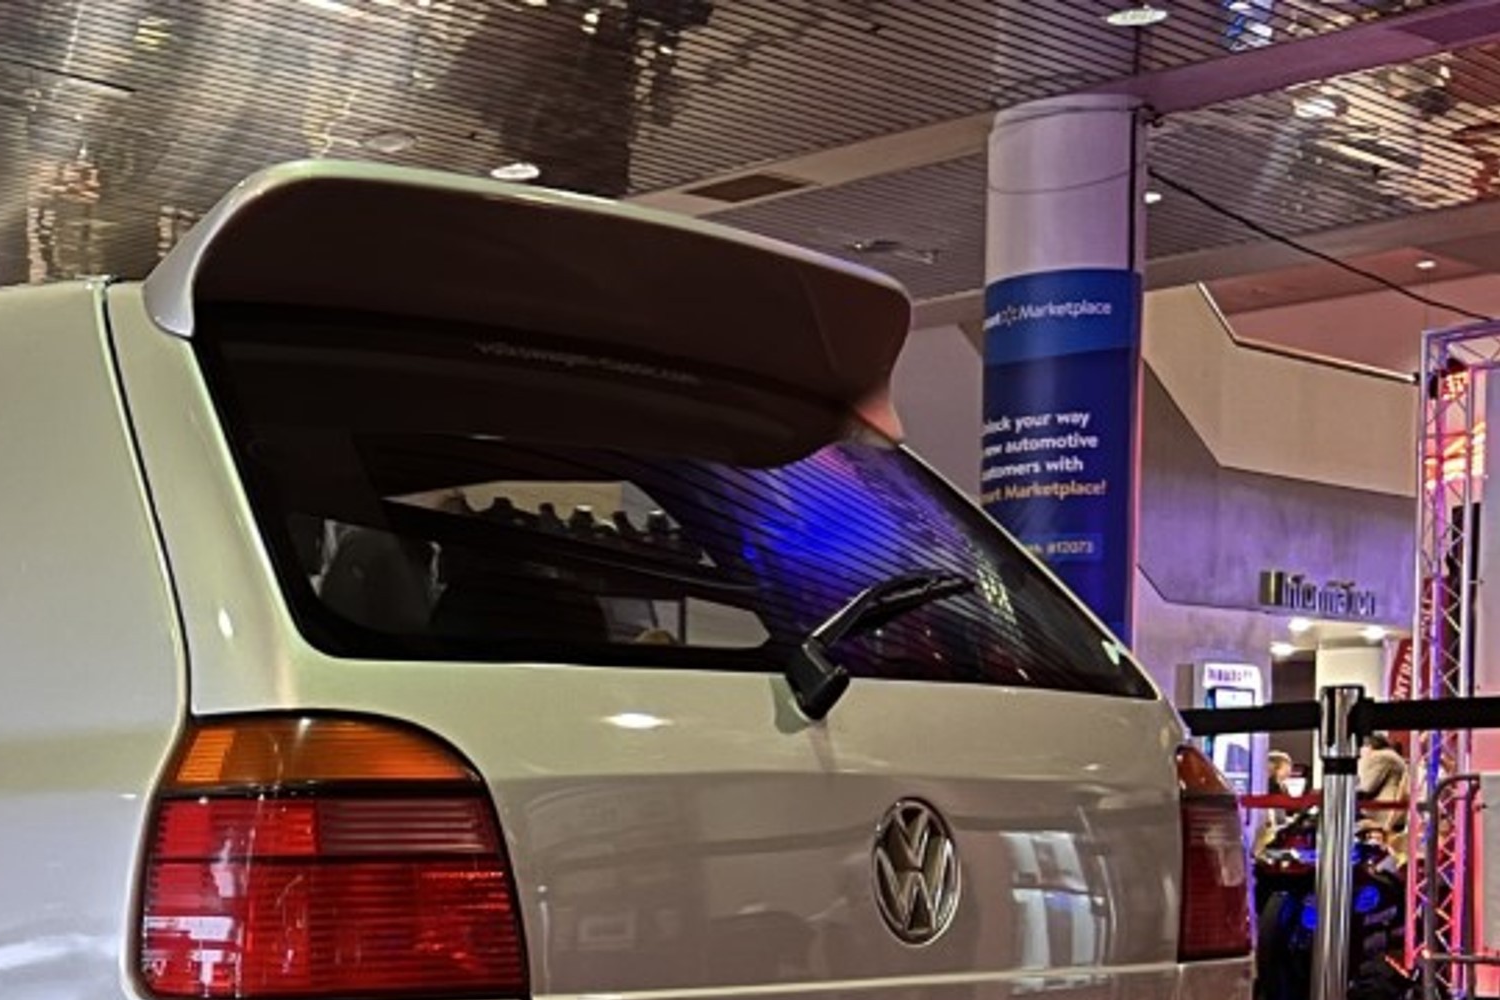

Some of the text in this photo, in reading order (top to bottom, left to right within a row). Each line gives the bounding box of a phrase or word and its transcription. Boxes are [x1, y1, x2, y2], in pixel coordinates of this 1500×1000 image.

[1021, 299, 1112, 319] Marketplace
[1015, 414, 1051, 434] your
[1054, 412, 1090, 429] way
[1005, 432, 1099, 453] automotive
[1044, 455, 1084, 472] with
[1004, 479, 1106, 500] Marketplace!
